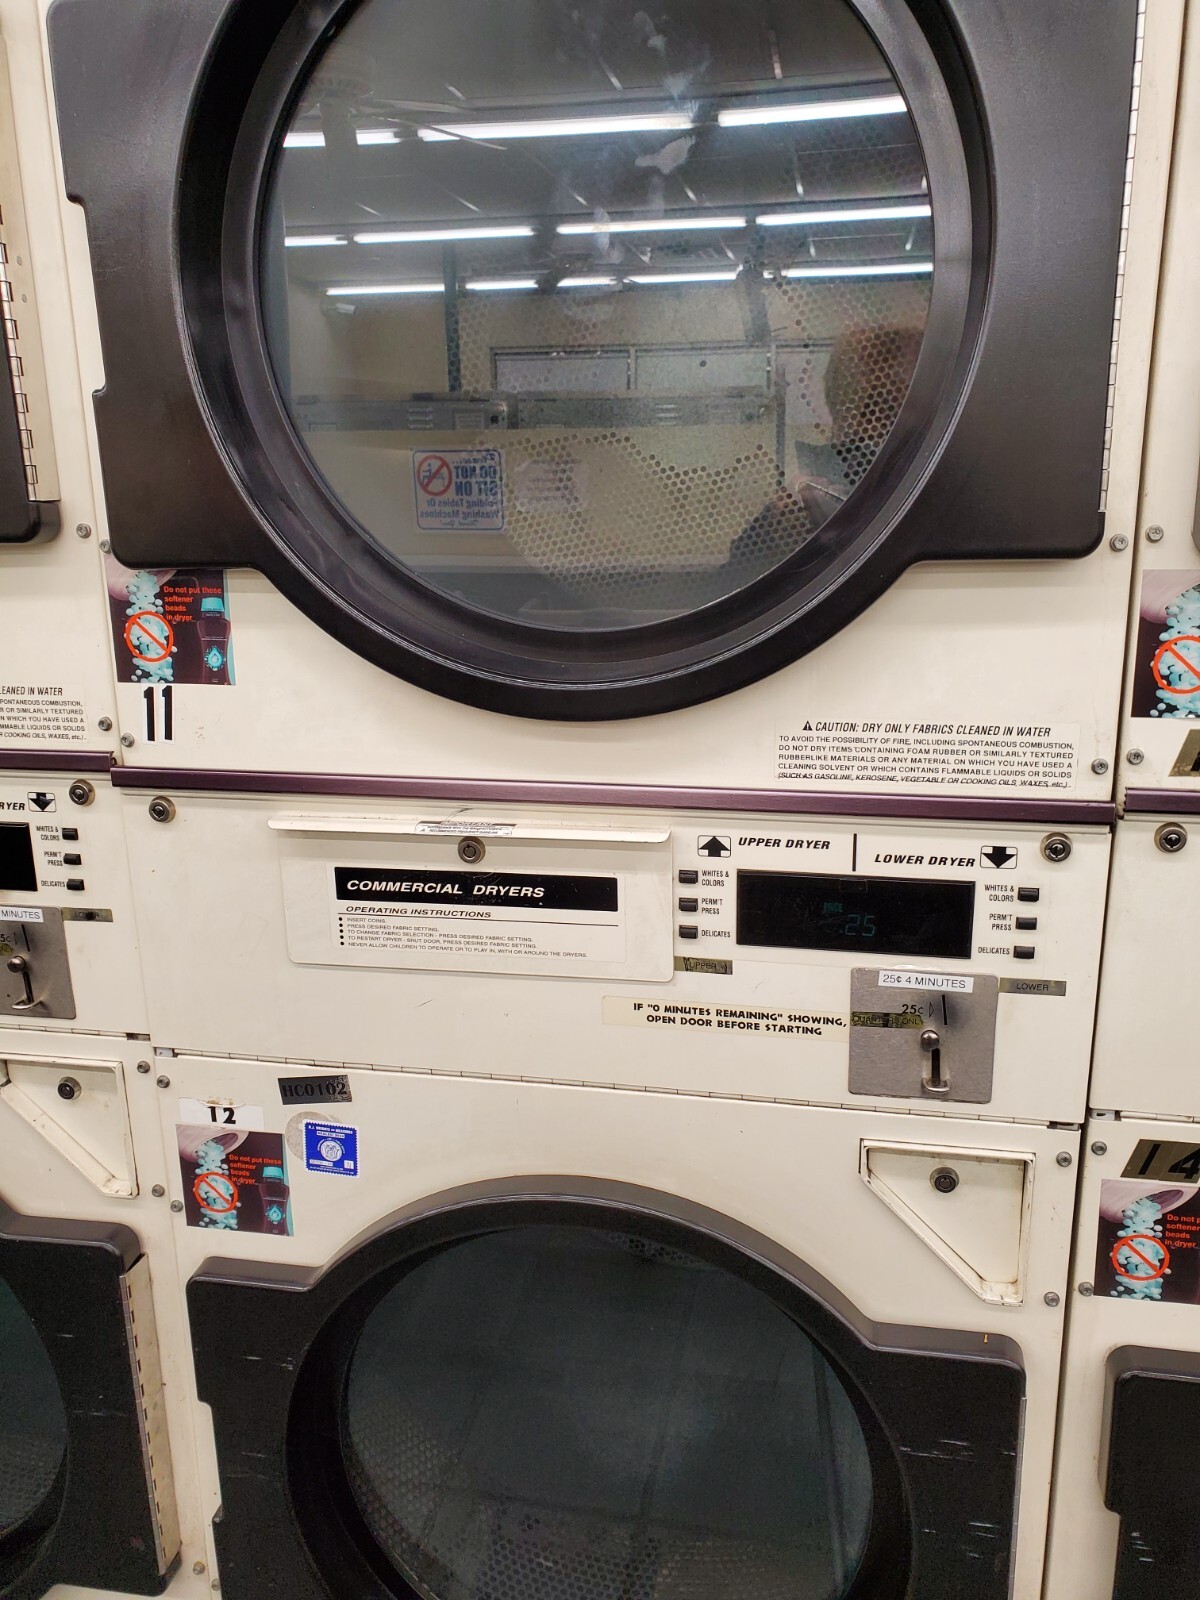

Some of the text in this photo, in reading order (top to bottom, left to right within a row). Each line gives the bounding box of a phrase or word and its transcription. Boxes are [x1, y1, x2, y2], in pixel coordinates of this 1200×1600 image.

[189, 586, 200, 594] put
[165, 604, 186, 612] beads
[175, 614, 192, 622] dryer
[28, 687, 34, 695] IN
[38, 686, 62, 696] WATER
[143, 685, 173, 742] 11
[816, 722, 1051, 737] CAUTION: DRY ONLY FABRICS CLEANED IN WATER
[958, 740, 1017, 748] SPONTANEOUS
[1019, 742, 1074, 750] COMBUSTION,
[854, 746, 904, 754] CONTAINING
[933, 748, 966, 756] RUBBER
[1030, 751, 1073, 759] TEXTURED
[899, 766, 939, 774] CONTAINS
[994, 769, 1025, 777] LIQUIDS
[738, 837, 830, 850] UPPER DRYER
[874, 853, 975, 867] LOWER DRYER
[41, 880, 65, 888] DELICATES
[702, 879, 724, 887] COLORS
[347, 880, 545, 898] COMMERCIAL DRYERS
[984, 884, 1007, 892] WHITES
[989, 894, 1014, 902] COLORS
[2, 910, 40, 919] MINUTES
[346, 906, 491, 918] OPERATING INSTRUCTIONS
[702, 907, 719, 915] PRESS
[702, 930, 730, 938] DELICATES
[978, 947, 1010, 955] DELICATES
[883, 974, 966, 989] 25¢ 4 MINUTES
[1017, 982, 1048, 991] LOWER
[634, 1003, 643, 1011] IF
[664, 1005, 710, 1016] MINUTES
[716, 1009, 782, 1021] REMAINING"
[788, 1014, 846, 1028] SHOWING,
[854, 1015, 899, 1025] QUARTRS
[647, 1015, 822, 1036] OPEN DOOR BEFORE STARTING
[207, 1106, 236, 1124] 12
[230, 1162, 256, 1170] softener
[1138, 1144, 1200, 1179] 14
[1167, 1223, 1200, 1231] softener
[1166, 1231, 1190, 1239] beads
[1175, 1240, 1196, 1248] dryer
